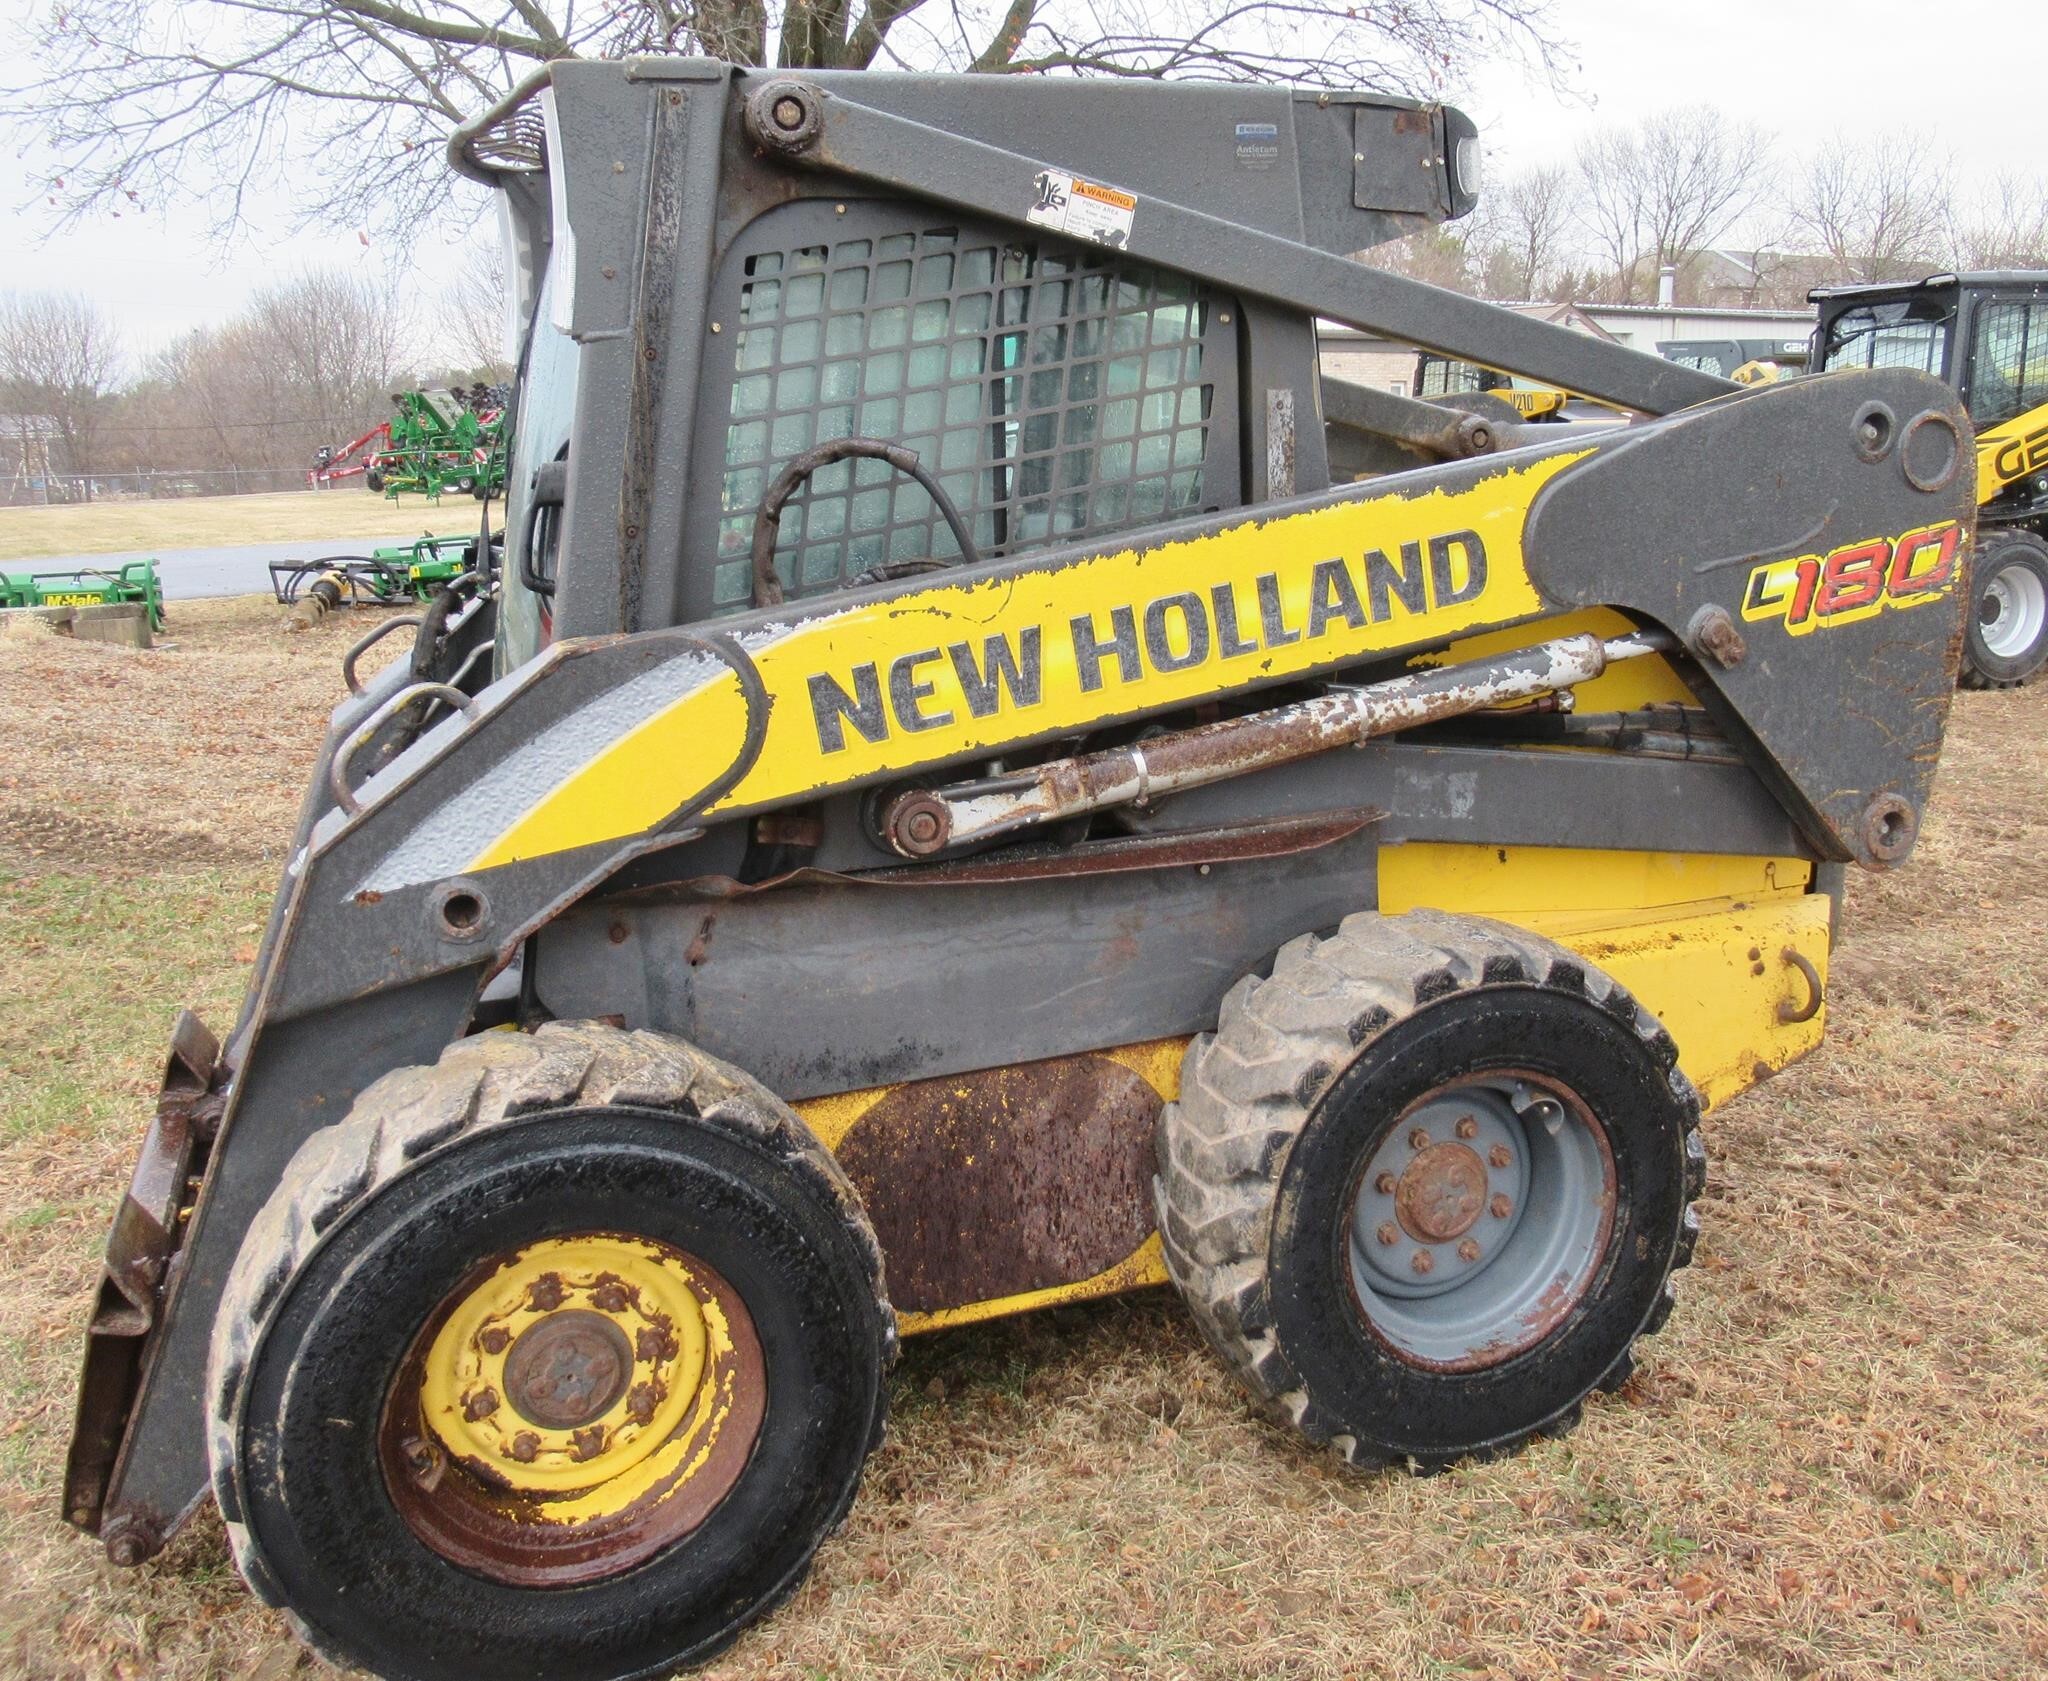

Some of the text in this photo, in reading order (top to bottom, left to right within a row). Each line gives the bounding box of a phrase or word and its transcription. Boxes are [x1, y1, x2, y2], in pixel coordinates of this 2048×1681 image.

[1087, 187, 1130, 206] WARNING
[1102, 206, 1119, 216] AREA
[1783, 342, 1808, 353] GEH
[806, 528, 1487, 755] NEW HOLLAND
